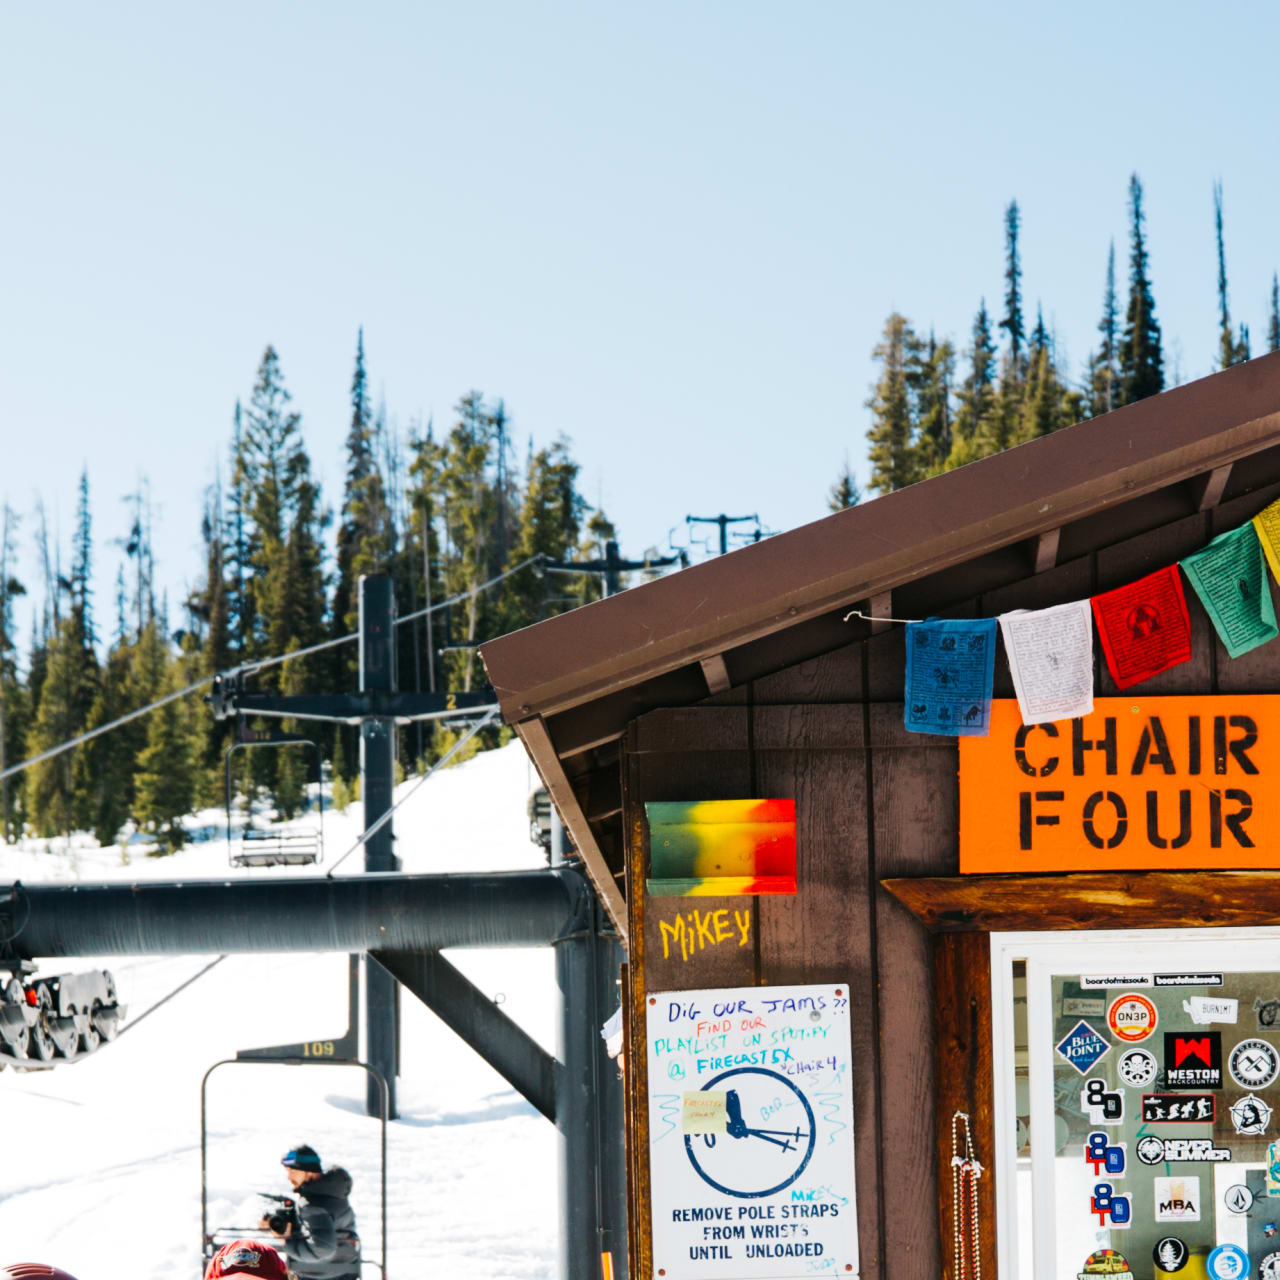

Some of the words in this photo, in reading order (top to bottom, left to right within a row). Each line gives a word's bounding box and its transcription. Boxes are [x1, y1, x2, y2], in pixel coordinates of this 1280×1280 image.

[1015, 716, 1259, 777] CHAIR
[1019, 789, 1255, 850] FOUR
[713, 1000, 752, 1017] OUR
[740, 1016, 766, 1031] OUR
[1118, 1012, 1147, 1021] ON3P
[302, 1041, 334, 1056] 109
[1064, 1042, 1103, 1058] JOINT
[1168, 1069, 1219, 1079] WESTON
[1165, 1140, 1212, 1150] NEVER
[1165, 1150, 1230, 1161] SUMMER
[672, 1207, 733, 1222] REMOVE
[738, 1205, 775, 1220] POLE
[781, 1203, 839, 1218] STRAPS
[1160, 1199, 1196, 1213] MBA
[704, 1226, 745, 1240] FROM
[751, 1224, 809, 1238] WRISTS
[689, 1246, 733, 1260] UNTIL
[746, 1243, 824, 1259] UNLOADED
